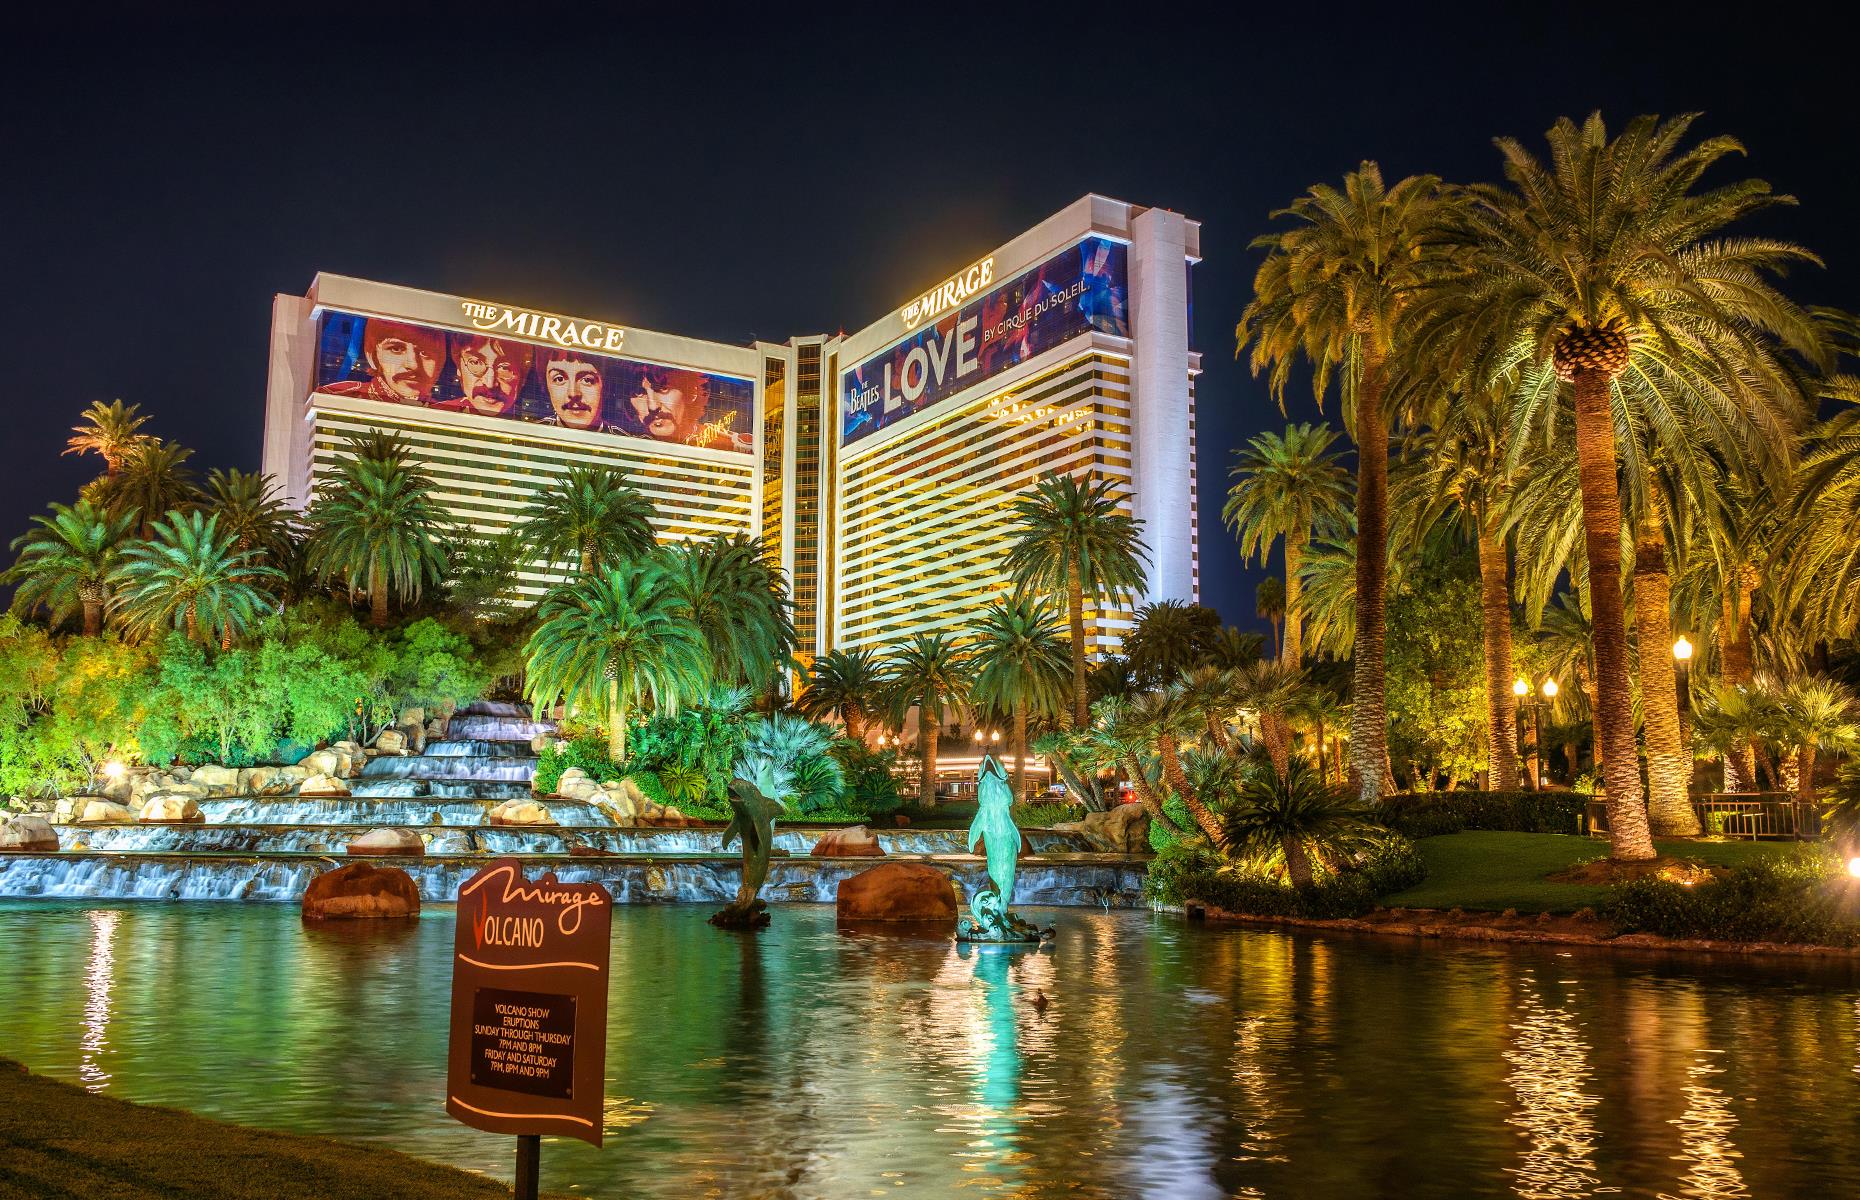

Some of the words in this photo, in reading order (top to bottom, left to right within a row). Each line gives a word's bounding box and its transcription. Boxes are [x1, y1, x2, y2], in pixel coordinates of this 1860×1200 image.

[907, 258, 994, 329] MIRAGE
[462, 302, 497, 320] THE
[902, 301, 920, 322] THE
[984, 326, 998, 342] BY
[997, 307, 1033, 334] CIRQUE
[1035, 300, 1049, 317] DU
[472, 309, 624, 351] MIRAGE
[883, 315, 978, 415] LOVE
[462, 866, 604, 936] Mirage
[473, 888, 545, 951] VOLCANO
[495, 1004, 527, 1016] VOLCANO
[528, 1008, 549, 1018] SHOW
[503, 1017, 539, 1029] ERUPTIONS
[474, 1025, 499, 1036] SUNDAY
[500, 1028, 533, 1040] THROUGH
[534, 1032, 571, 1045] THURSDAY
[498, 1039, 511, 1049] 7PM
[512, 1042, 527, 1051] AND
[528, 1043, 542, 1053] 8PM
[484, 1049, 506, 1060] FRIDAY
[506, 1053, 521, 1062] AND
[522, 1054, 557, 1067] SATURDAY
[490, 1061, 504, 1072] 7PM,
[505, 1064, 518, 1073] 8PM
[519, 1066, 535, 1076] AND
[535, 1068, 549, 1078] 9PM
